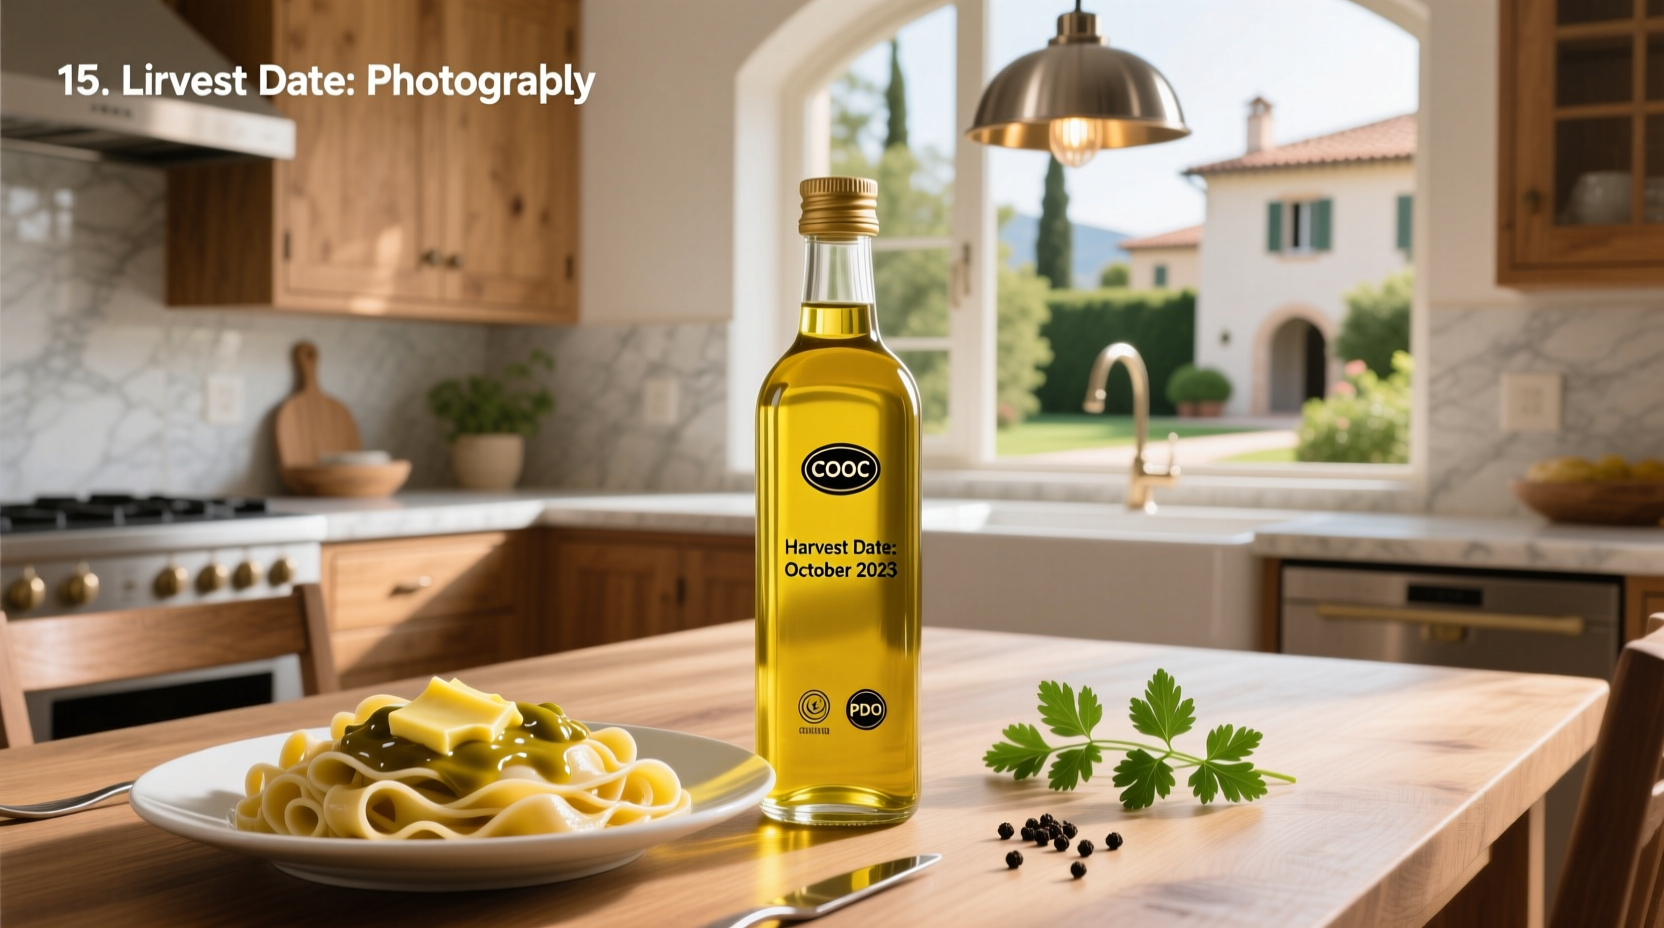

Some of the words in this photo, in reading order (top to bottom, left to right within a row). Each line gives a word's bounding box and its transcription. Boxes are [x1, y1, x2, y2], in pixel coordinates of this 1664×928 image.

[811, 459, 871, 479] COOC
[785, 538, 848, 555] Harvest
[853, 538, 898, 555] Date:
[784, 561, 852, 578] October
[856, 561, 898, 579] 2023
[849, 702, 883, 718] PDO
